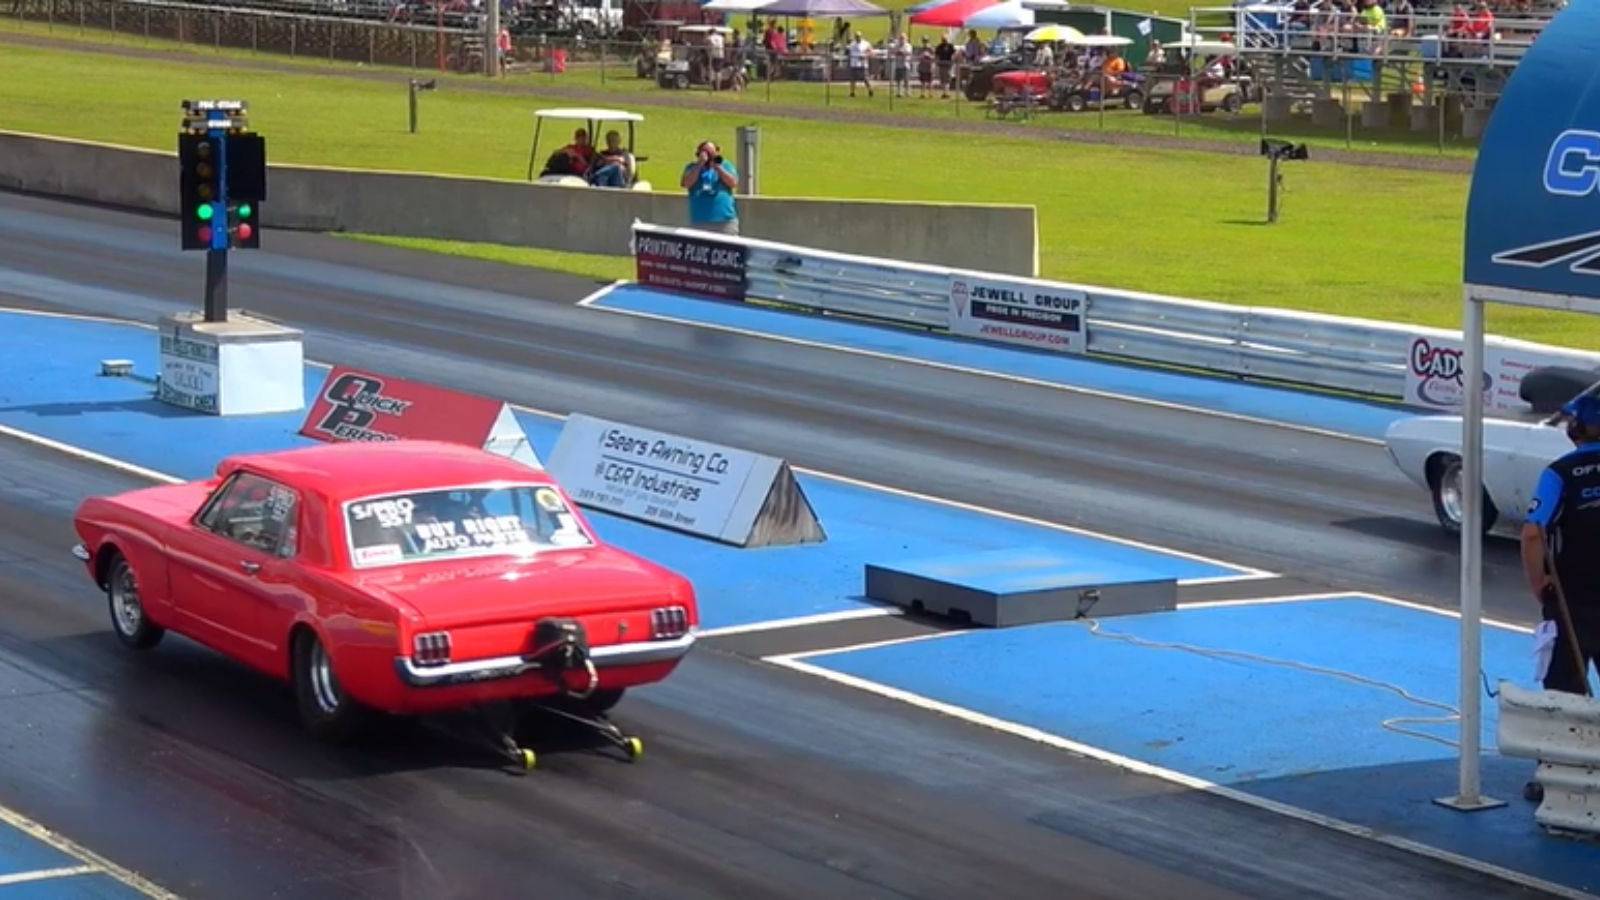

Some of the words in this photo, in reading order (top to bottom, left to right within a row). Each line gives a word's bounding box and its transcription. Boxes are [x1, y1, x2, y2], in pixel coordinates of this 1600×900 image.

[1543, 129, 1600, 195] C
[970, 286, 1028, 304] JEWELL
[1035, 293, 1080, 310] GROUP
[325, 372, 413, 416] QUICK
[604, 429, 649, 457] Sears
[650, 439, 704, 474] Awning
[635, 468, 702, 502] Industries
[415, 521, 456, 539] BUY
[463, 516, 522, 535] RIGHT
[424, 534, 470, 552] AUTO
